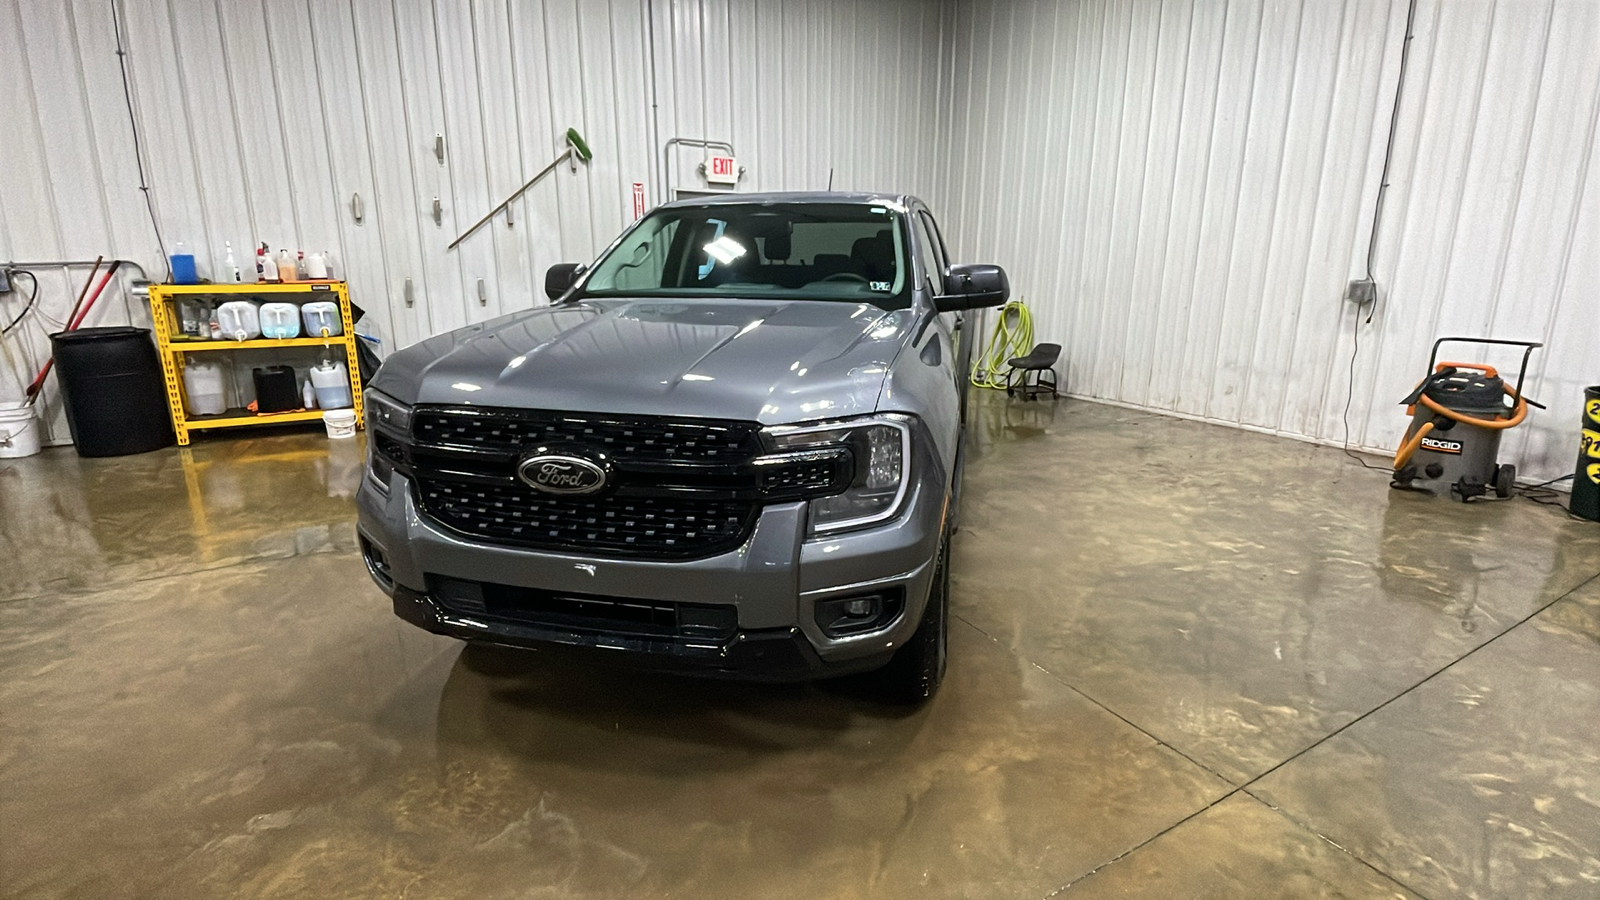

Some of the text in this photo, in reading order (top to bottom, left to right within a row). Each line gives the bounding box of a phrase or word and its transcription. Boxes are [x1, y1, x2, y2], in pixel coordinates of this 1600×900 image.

[713, 157, 733, 175] EXIT
[1421, 437, 1461, 450] RIDGID
[537, 463, 582, 486] Ford
